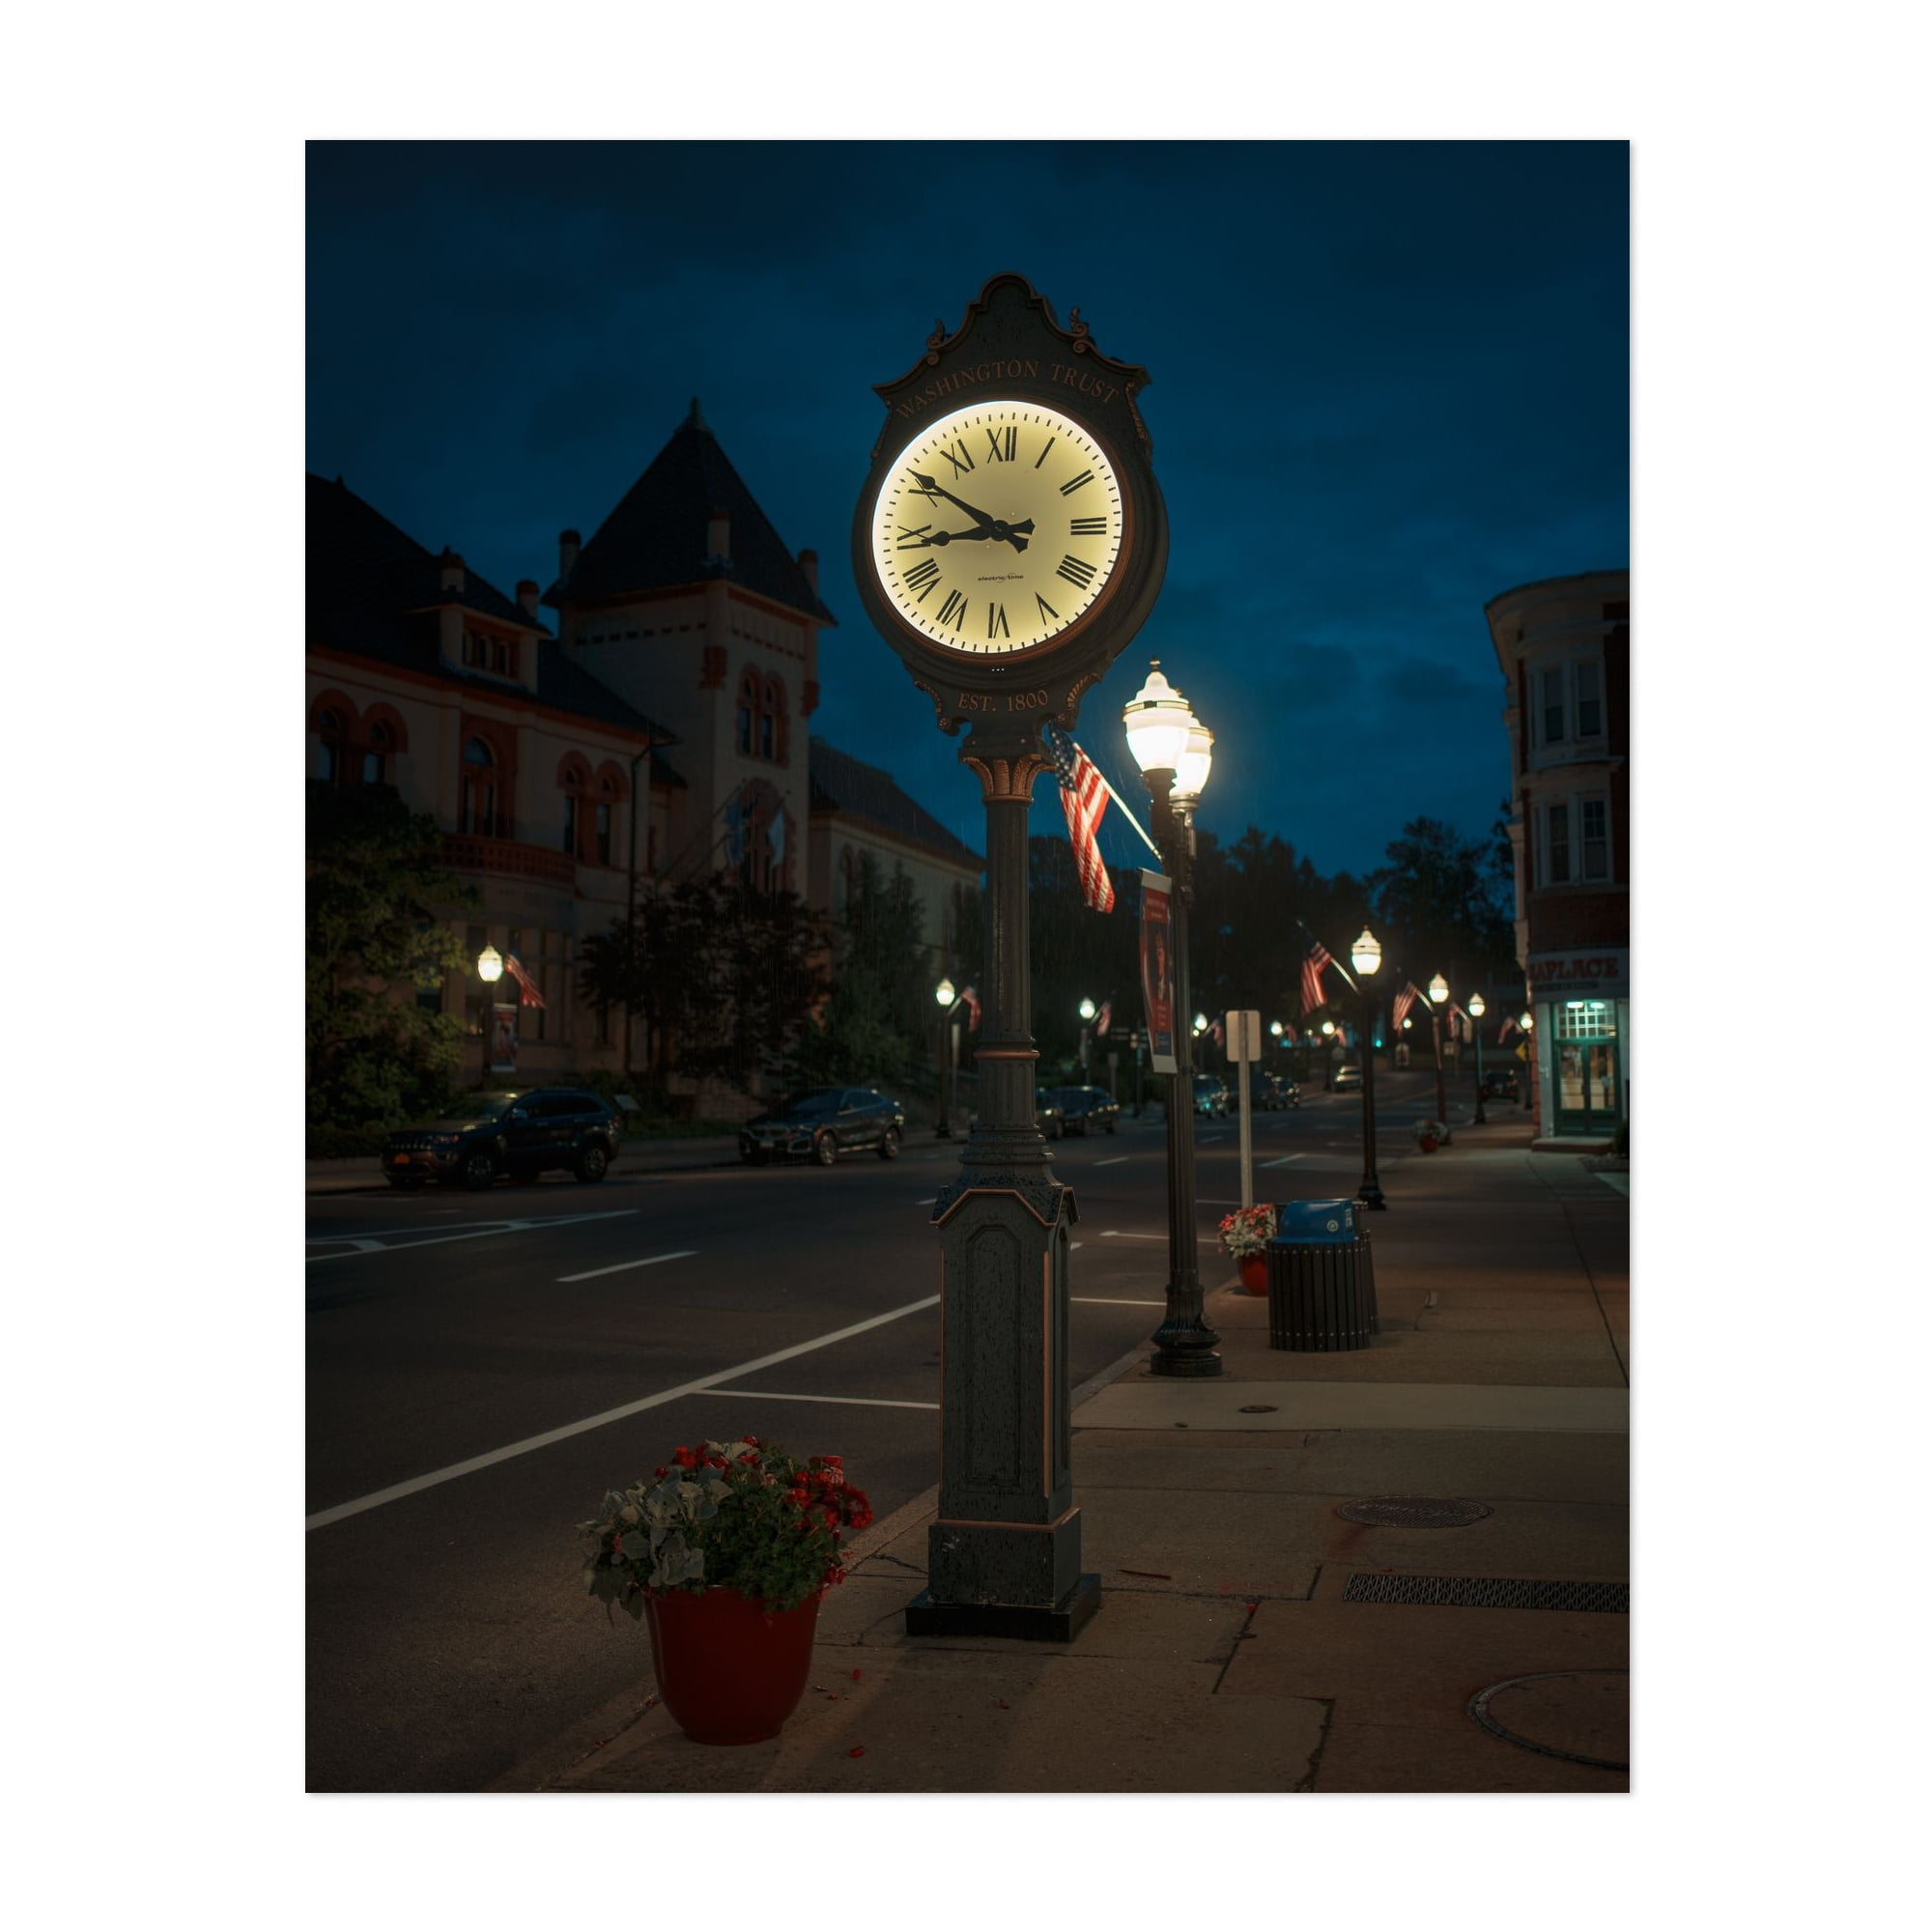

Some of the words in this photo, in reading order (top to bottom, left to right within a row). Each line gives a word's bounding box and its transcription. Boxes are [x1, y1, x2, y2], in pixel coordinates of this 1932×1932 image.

[896, 360, 1040, 419] WASHINGTON
[1051, 363, 1120, 405] TRUST
[939, 439, 976, 480] XI
[987, 426, 1017, 464] XII
[908, 478, 945, 507] X
[1060, 469, 1094, 497] II
[1070, 517, 1107, 535] III
[902, 557, 943, 604] VIII
[1056, 554, 1097, 590] IIII
[935, 589, 969, 632] VII
[987, 602, 1010, 639] VI
[1035, 591, 1060, 626] V
[957, 692, 997, 712] EST.
[1008, 690, 1048, 712] 1800
